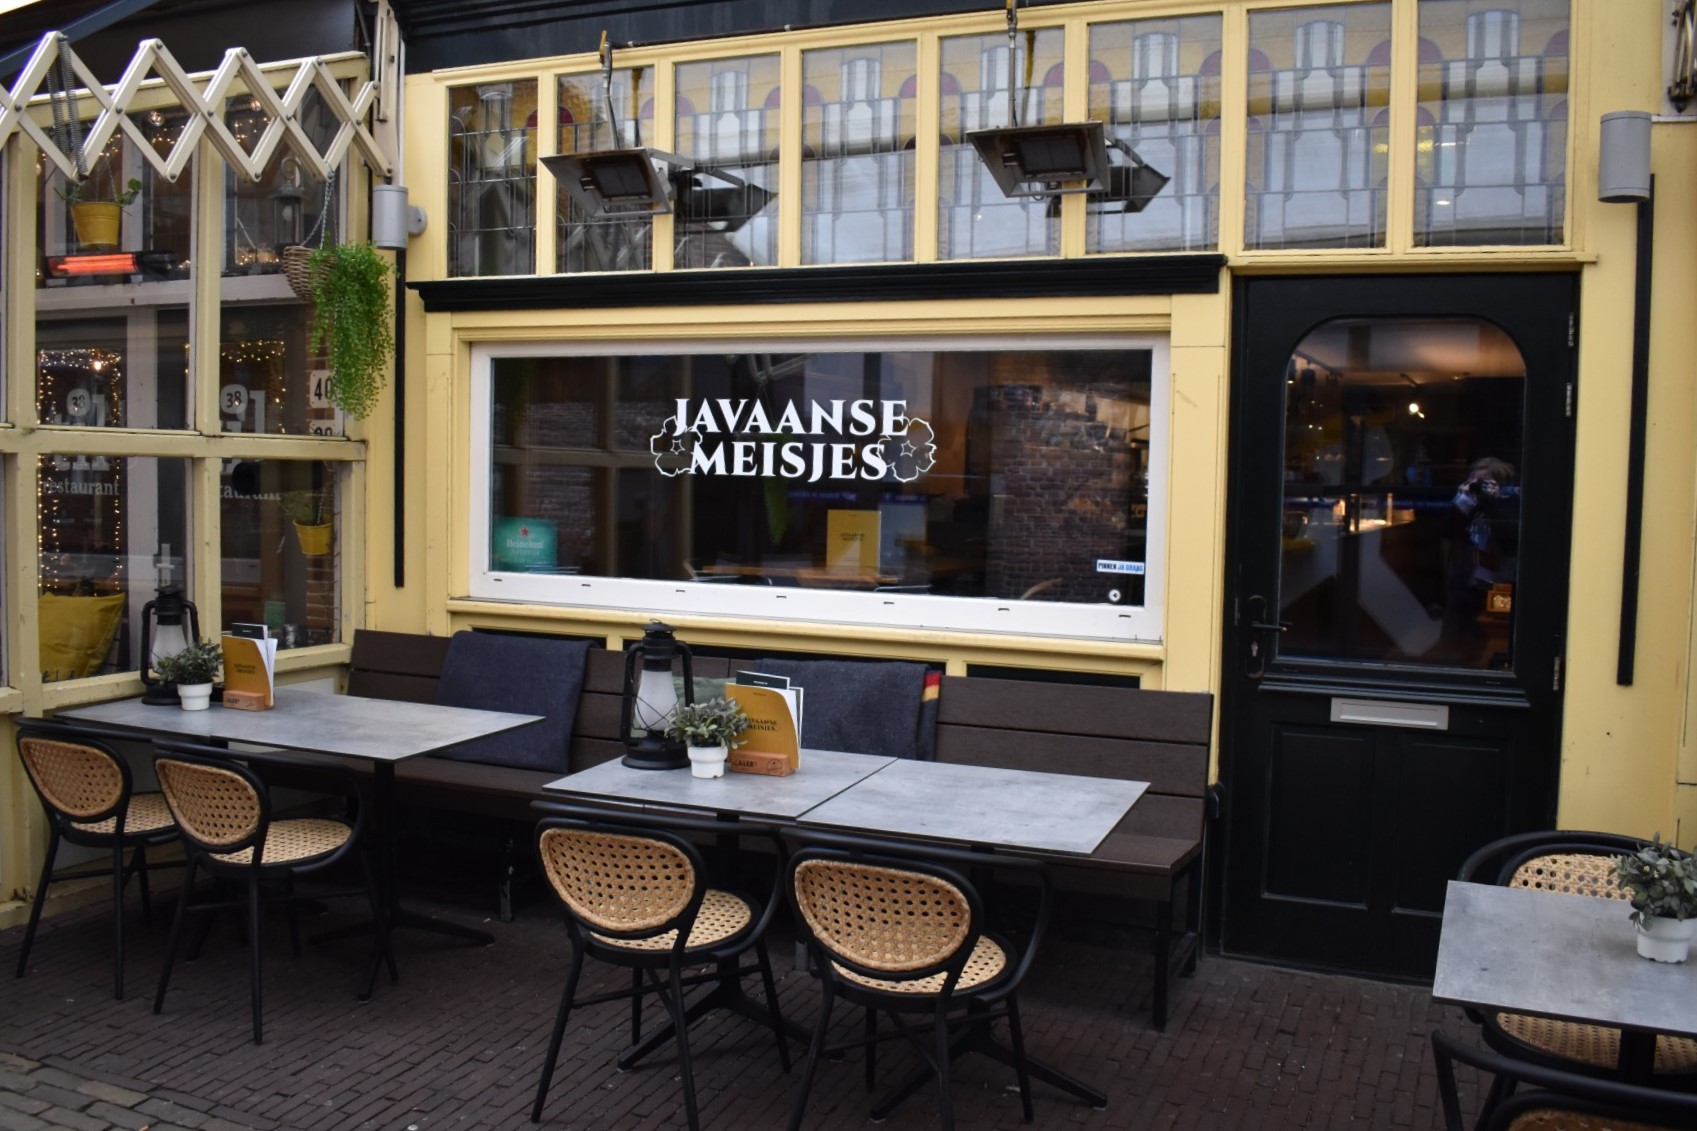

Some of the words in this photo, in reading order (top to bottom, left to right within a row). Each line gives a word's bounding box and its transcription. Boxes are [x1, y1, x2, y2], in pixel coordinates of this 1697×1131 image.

[226, 390, 242, 408] 38
[314, 377, 335, 401] 40
[673, 398, 908, 436] JAVAANSE
[689, 441, 888, 483] MEISJES
[43, 478, 120, 495] restaurant
[1098, 562, 1117, 570] PINNEN
